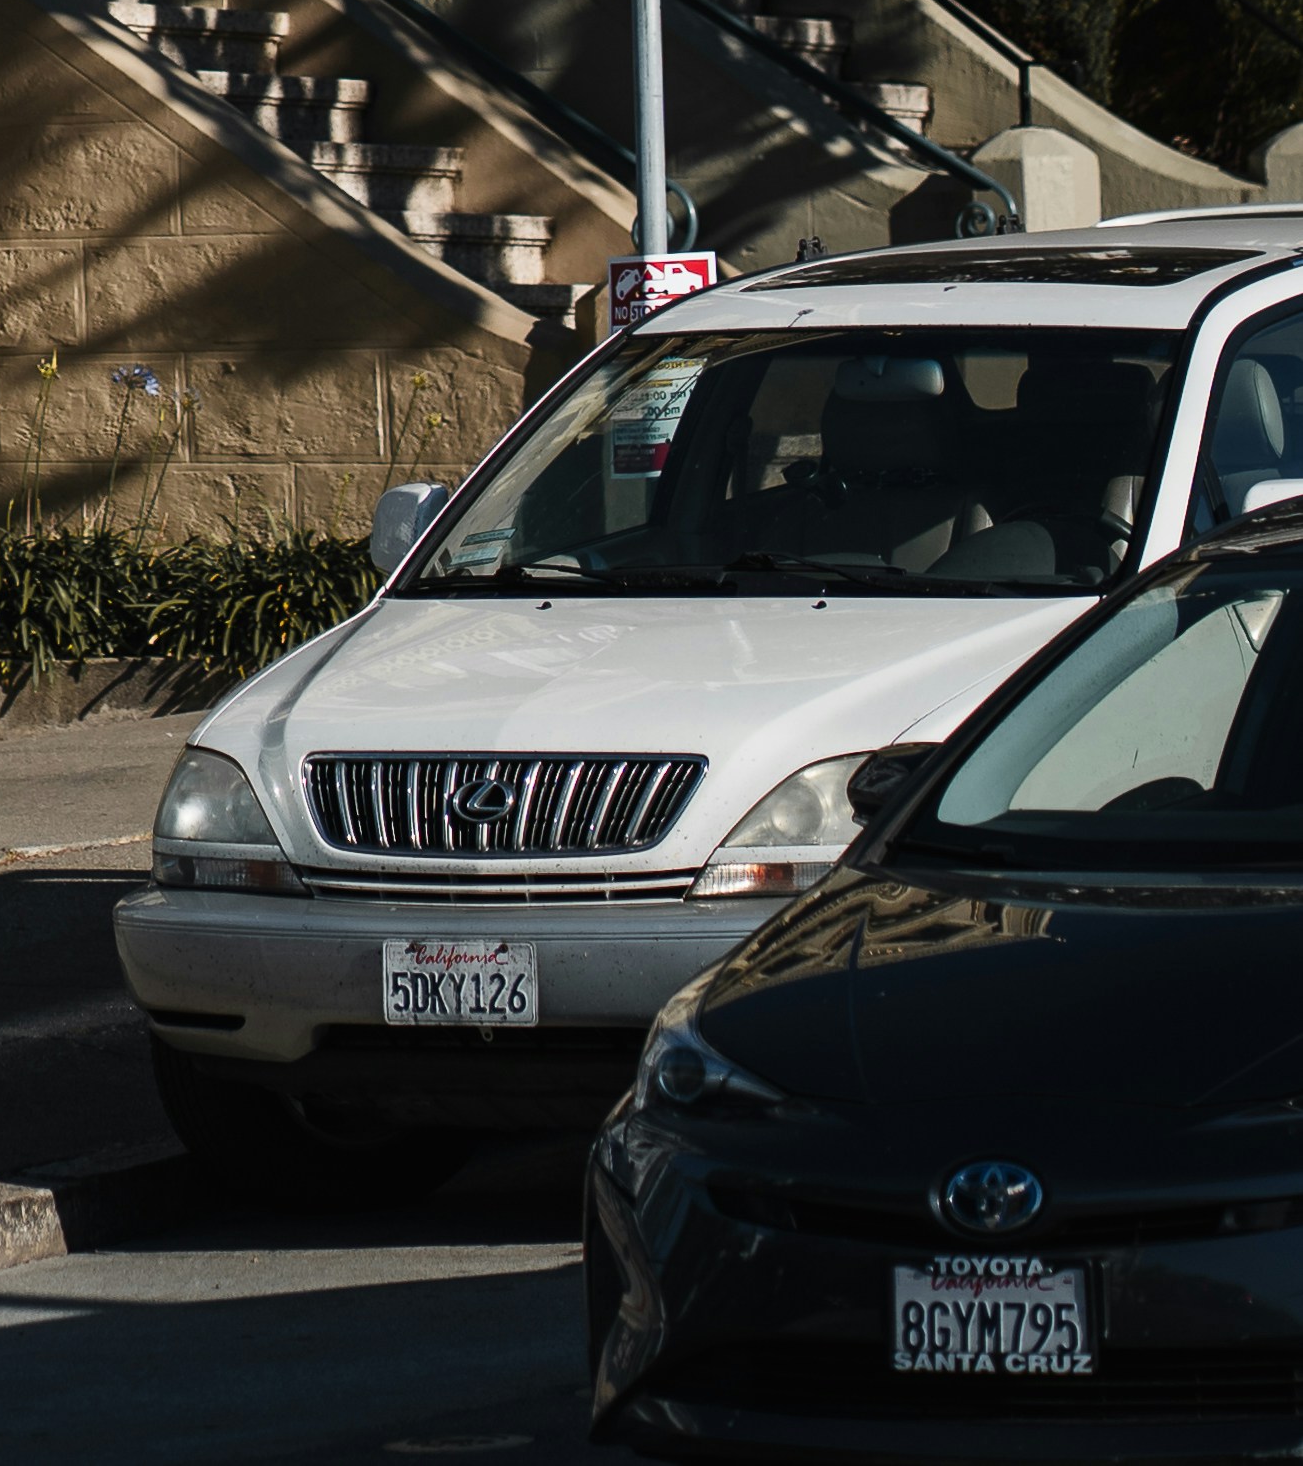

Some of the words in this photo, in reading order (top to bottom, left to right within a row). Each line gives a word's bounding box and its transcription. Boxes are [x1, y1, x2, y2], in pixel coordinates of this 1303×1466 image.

[614, 306, 628, 320] NO
[414, 944, 508, 970] California
[391, 972, 527, 1014] 5DKY126
[934, 1257, 1044, 1276] TOYOTA
[901, 1300, 1081, 1353] 8GYM795
[895, 1353, 995, 1372] SANTA
[1005, 1354, 1093, 1373] CRUZ
